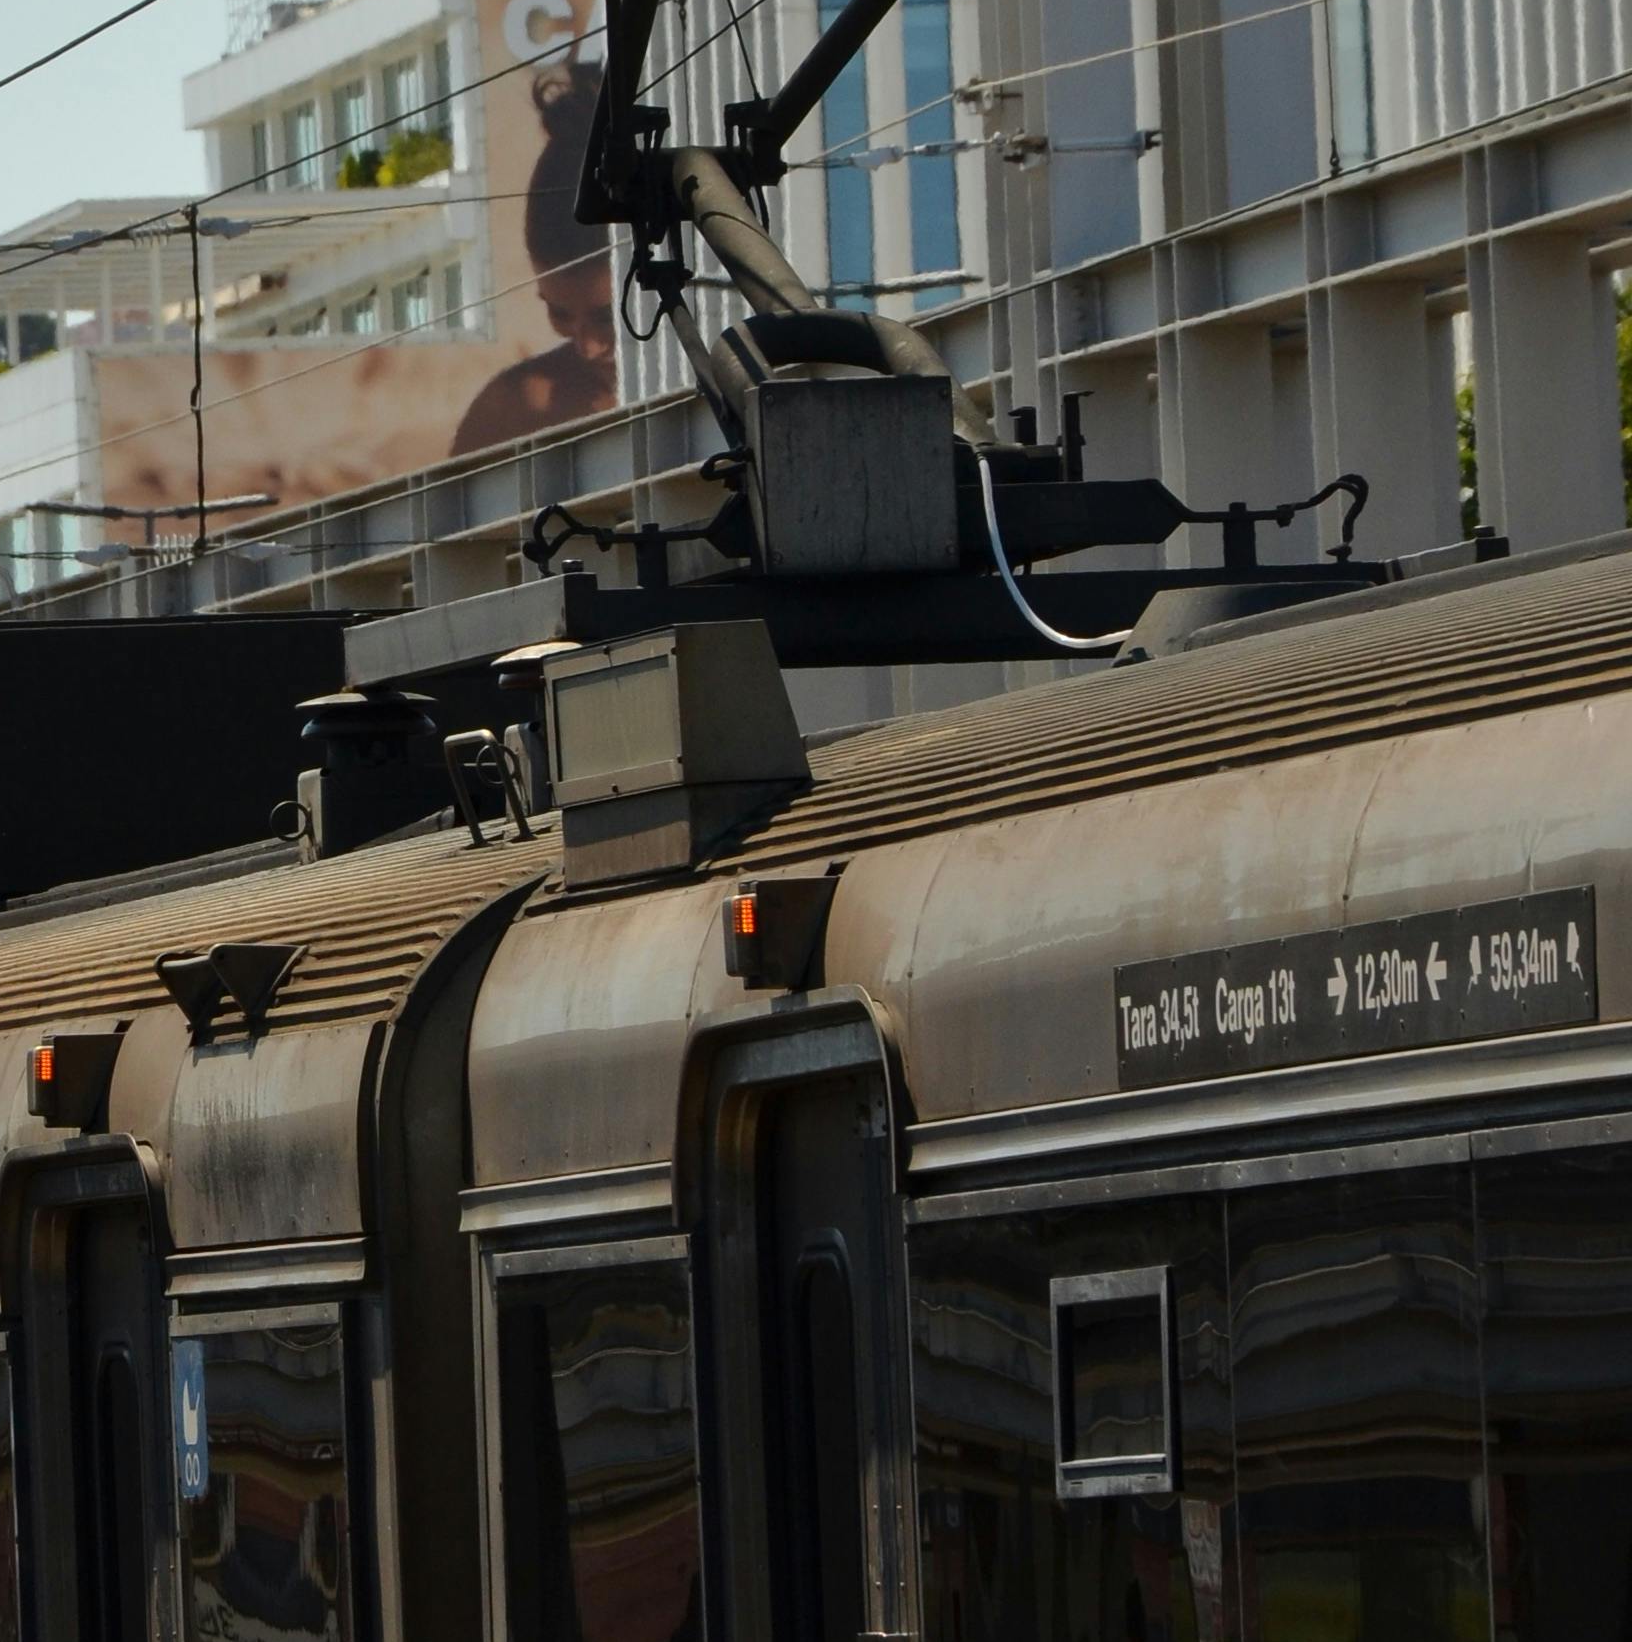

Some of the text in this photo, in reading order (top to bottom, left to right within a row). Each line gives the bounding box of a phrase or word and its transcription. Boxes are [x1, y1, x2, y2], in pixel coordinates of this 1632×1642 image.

[1120, 928, 1558, 1052] Tara 34,5t Carga 13t 12,30m 59,34m
